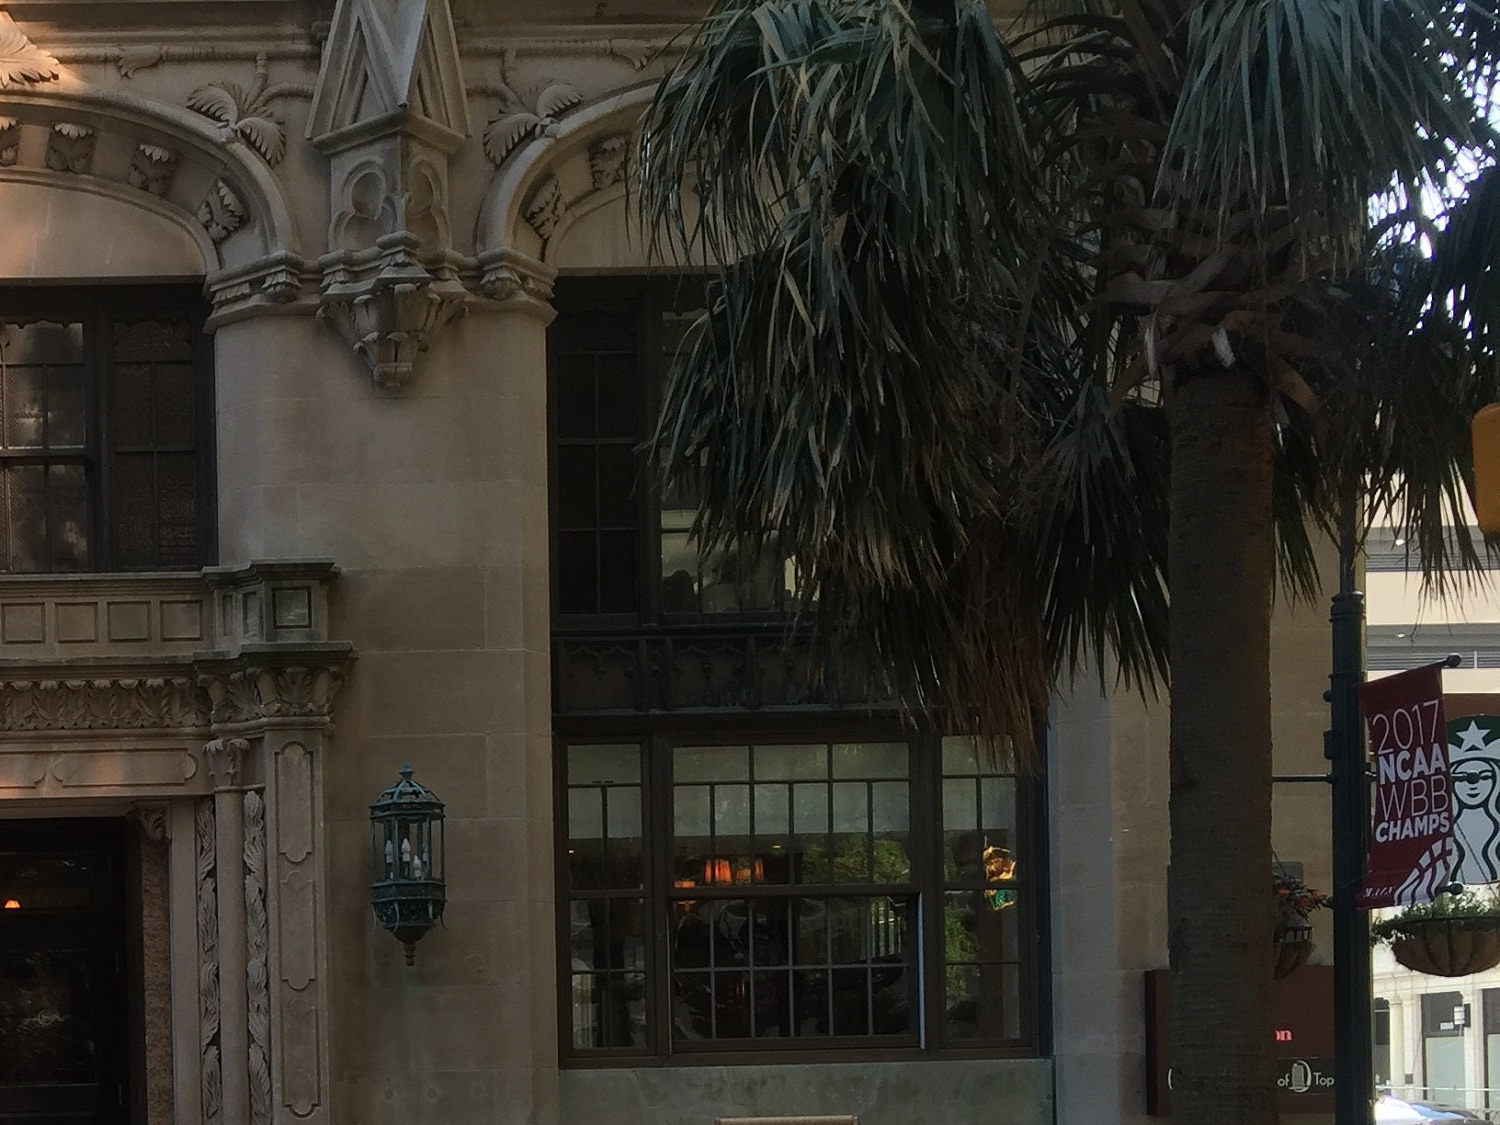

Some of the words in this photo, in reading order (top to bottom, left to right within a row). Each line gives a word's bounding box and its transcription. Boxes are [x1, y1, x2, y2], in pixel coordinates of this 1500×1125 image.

[1372, 699, 1440, 756] 2017
[1378, 742, 1447, 785] NCAA
[1379, 774, 1450, 821] WBB
[1375, 811, 1451, 843] CHAMPS
[1277, 1073, 1290, 1087] of
